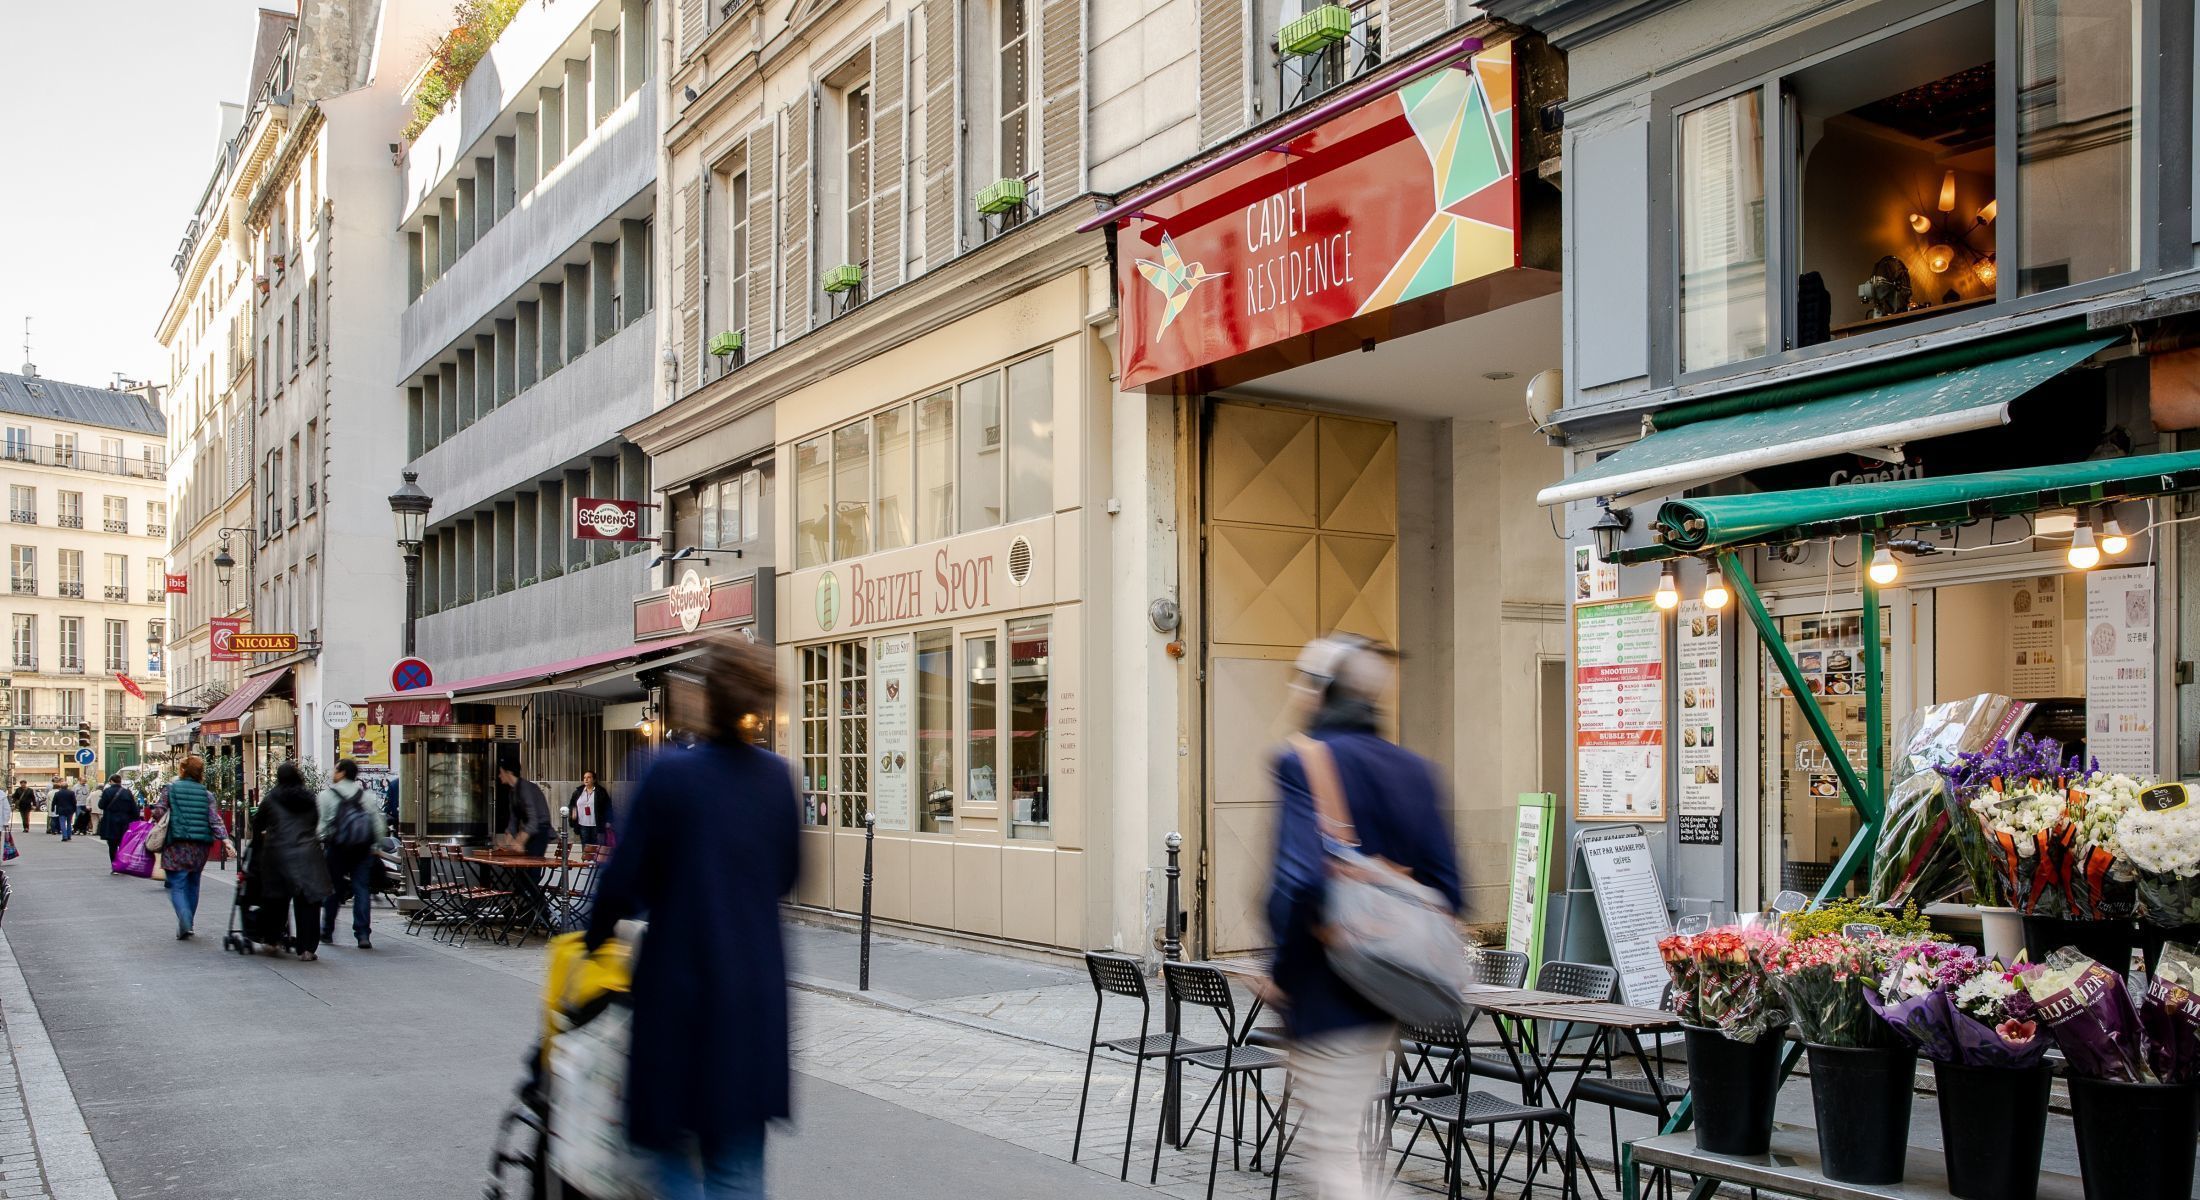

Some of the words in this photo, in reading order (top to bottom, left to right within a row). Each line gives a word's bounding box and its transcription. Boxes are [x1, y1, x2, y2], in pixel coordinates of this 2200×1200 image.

[1246, 182, 1307, 252] CADET
[1247, 230, 1354, 316] RESIDENCE
[580, 510, 635, 527] Stévenot
[169, 579, 186, 588] ibis
[850, 563, 923, 627] BREIZH
[935, 544, 993, 615] SPOT
[236, 638, 290, 649] NICOLAS
[1600, 667, 1639, 676] SMOOTHIES
[1800, 748, 1868, 770] GLAES
[1589, 848, 1602, 857] FAIT
[1602, 846, 1614, 855] PAR
[1614, 844, 1635, 853] MADAME
